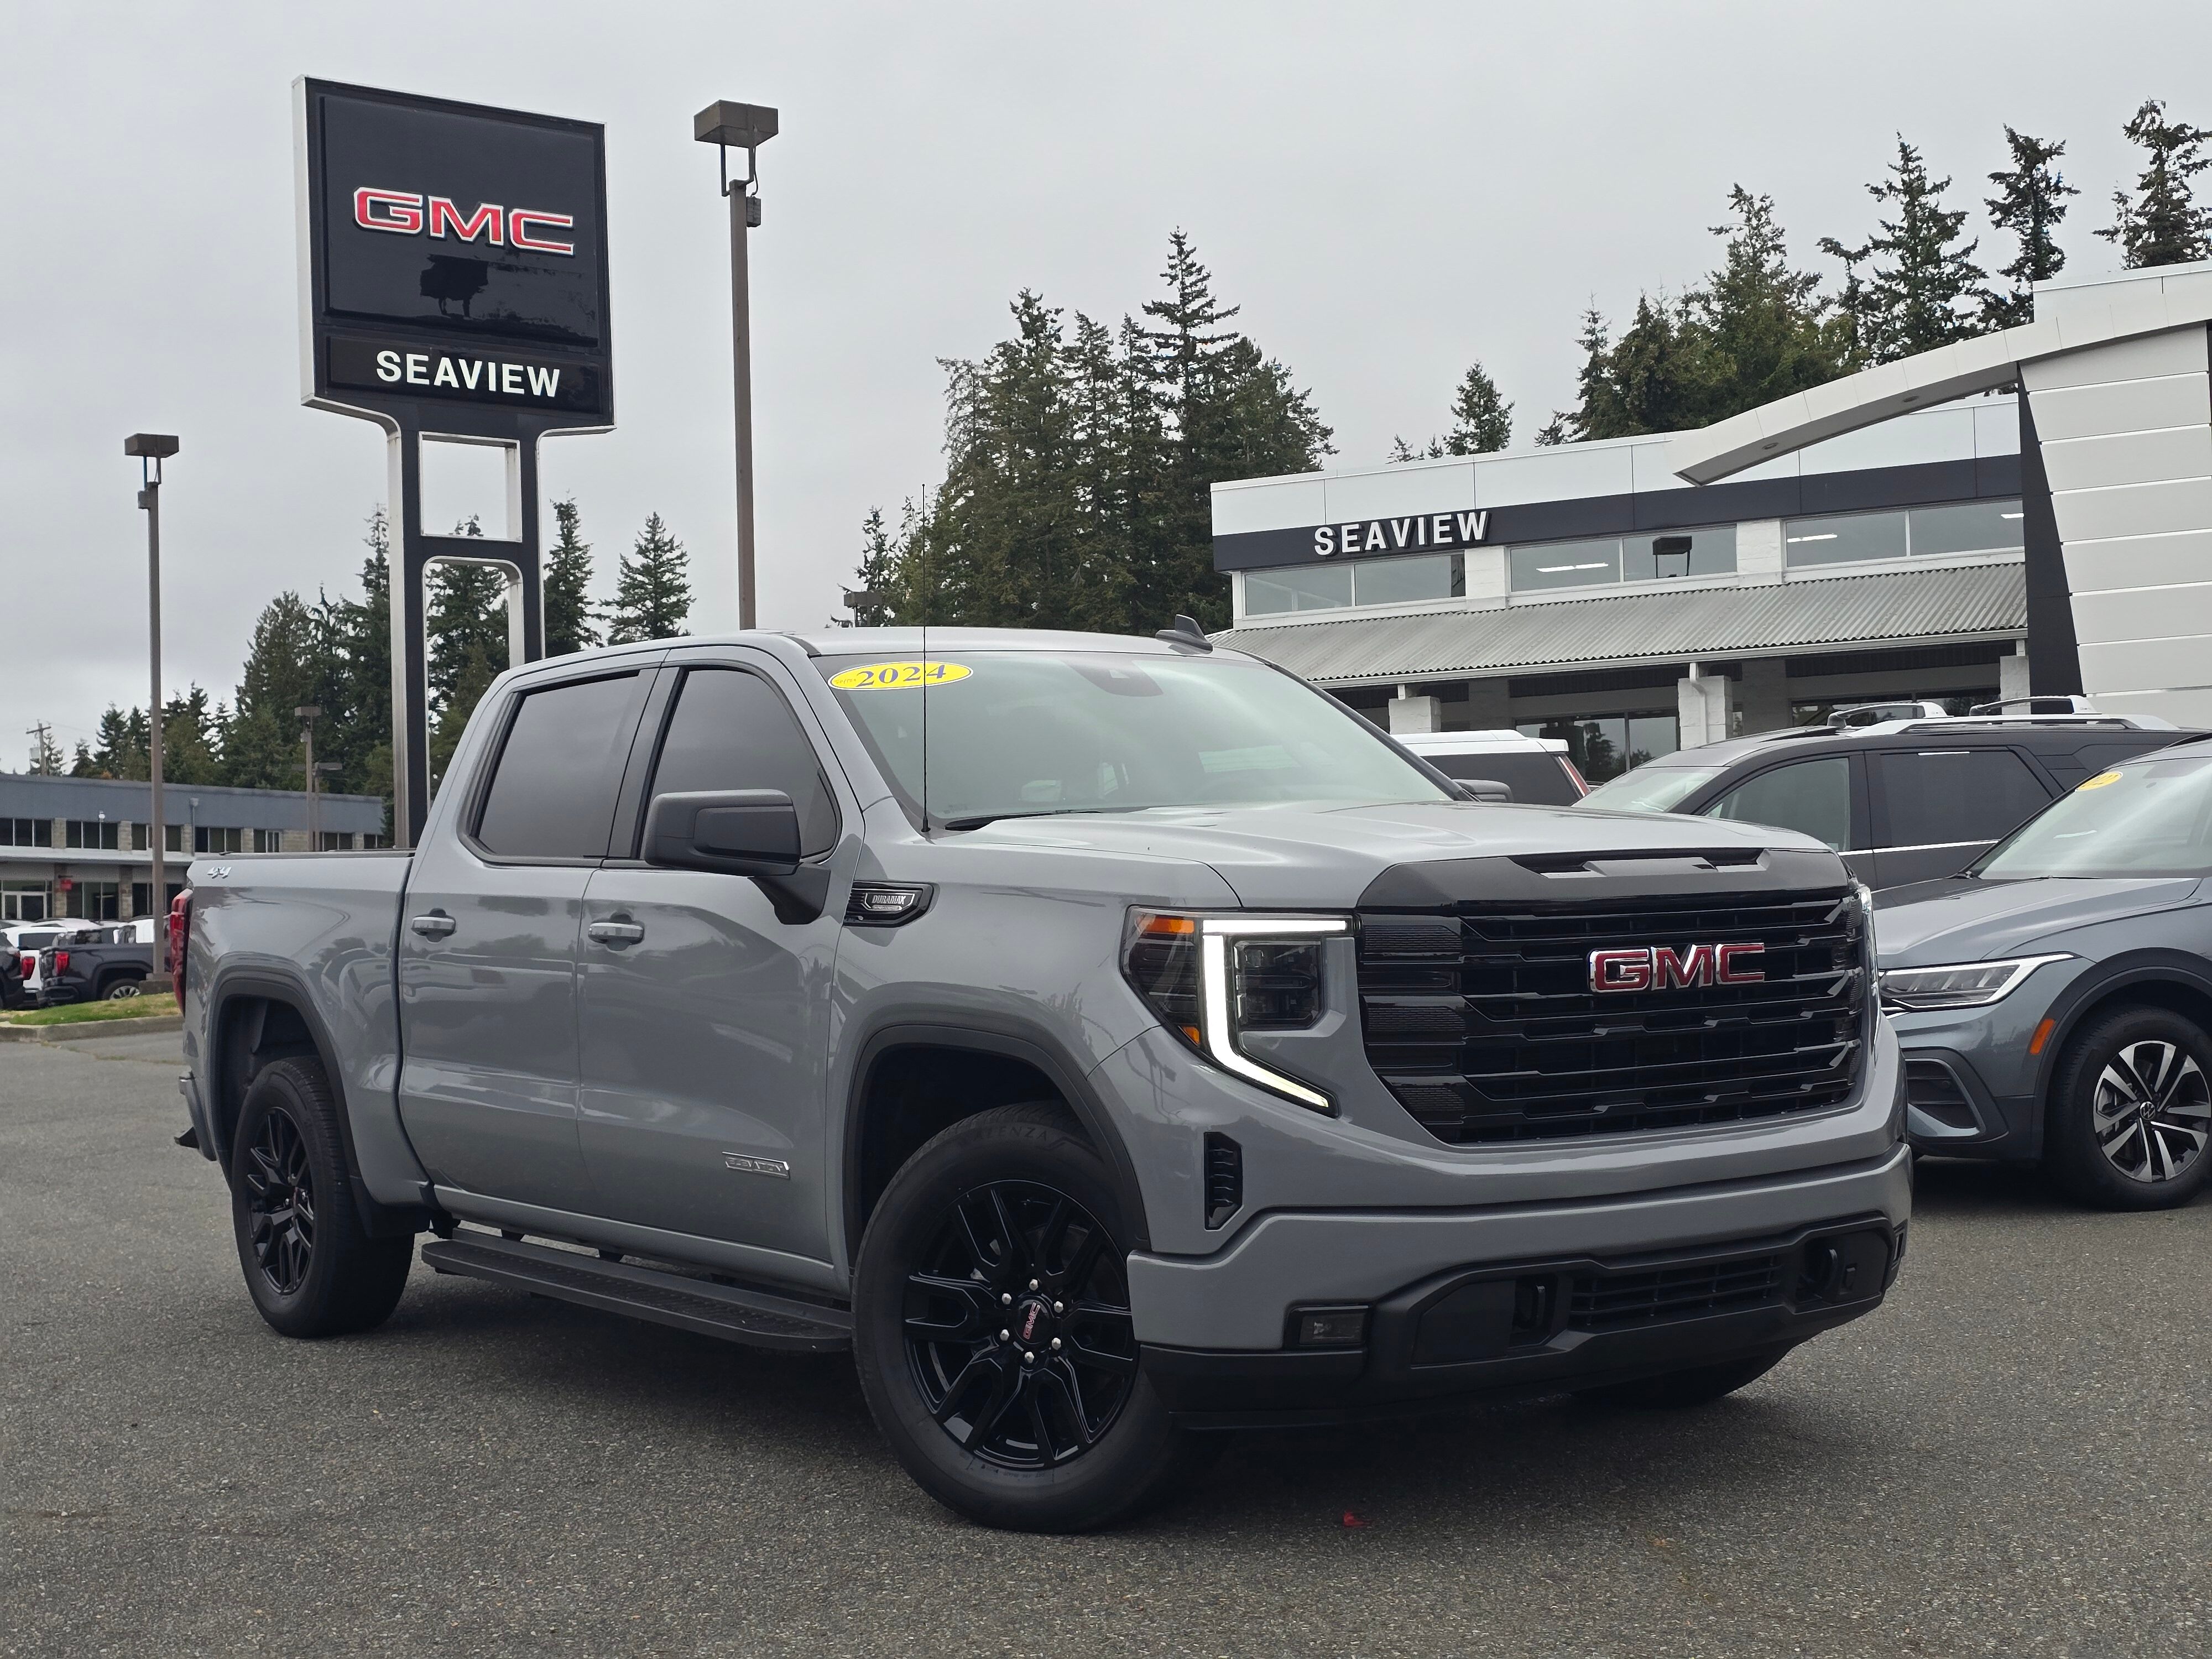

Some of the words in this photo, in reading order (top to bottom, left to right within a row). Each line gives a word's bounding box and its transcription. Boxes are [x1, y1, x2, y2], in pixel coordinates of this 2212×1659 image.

[353, 187, 574, 255] GMC
[377, 350, 560, 397] SEAVIEW
[1314, 511, 1489, 556] SEAVIEW
[856, 664, 946, 687] 2024
[872, 895, 906, 905] DURAMAX
[1589, 942, 1765, 993] GMC
[1023, 1302, 1041, 1339] GMC
